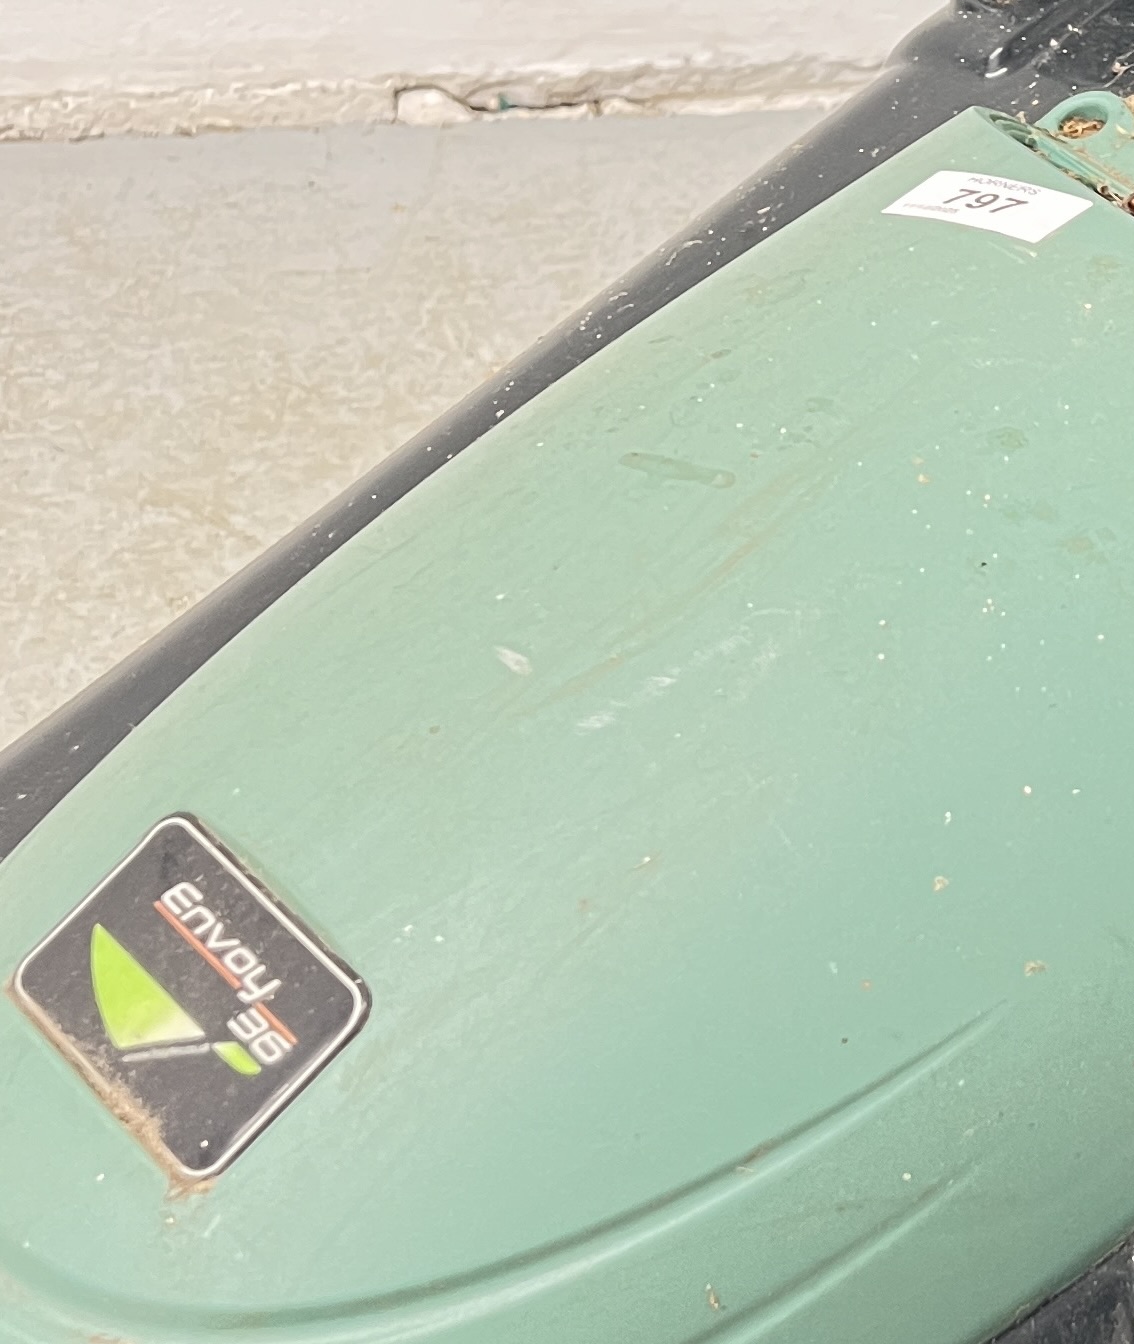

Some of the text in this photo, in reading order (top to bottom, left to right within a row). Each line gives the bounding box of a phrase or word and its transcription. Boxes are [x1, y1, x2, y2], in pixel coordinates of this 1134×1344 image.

[943, 188, 1029, 213] 797
[160, 881, 282, 1004] Envoy
[226, 1007, 293, 1065] 36
